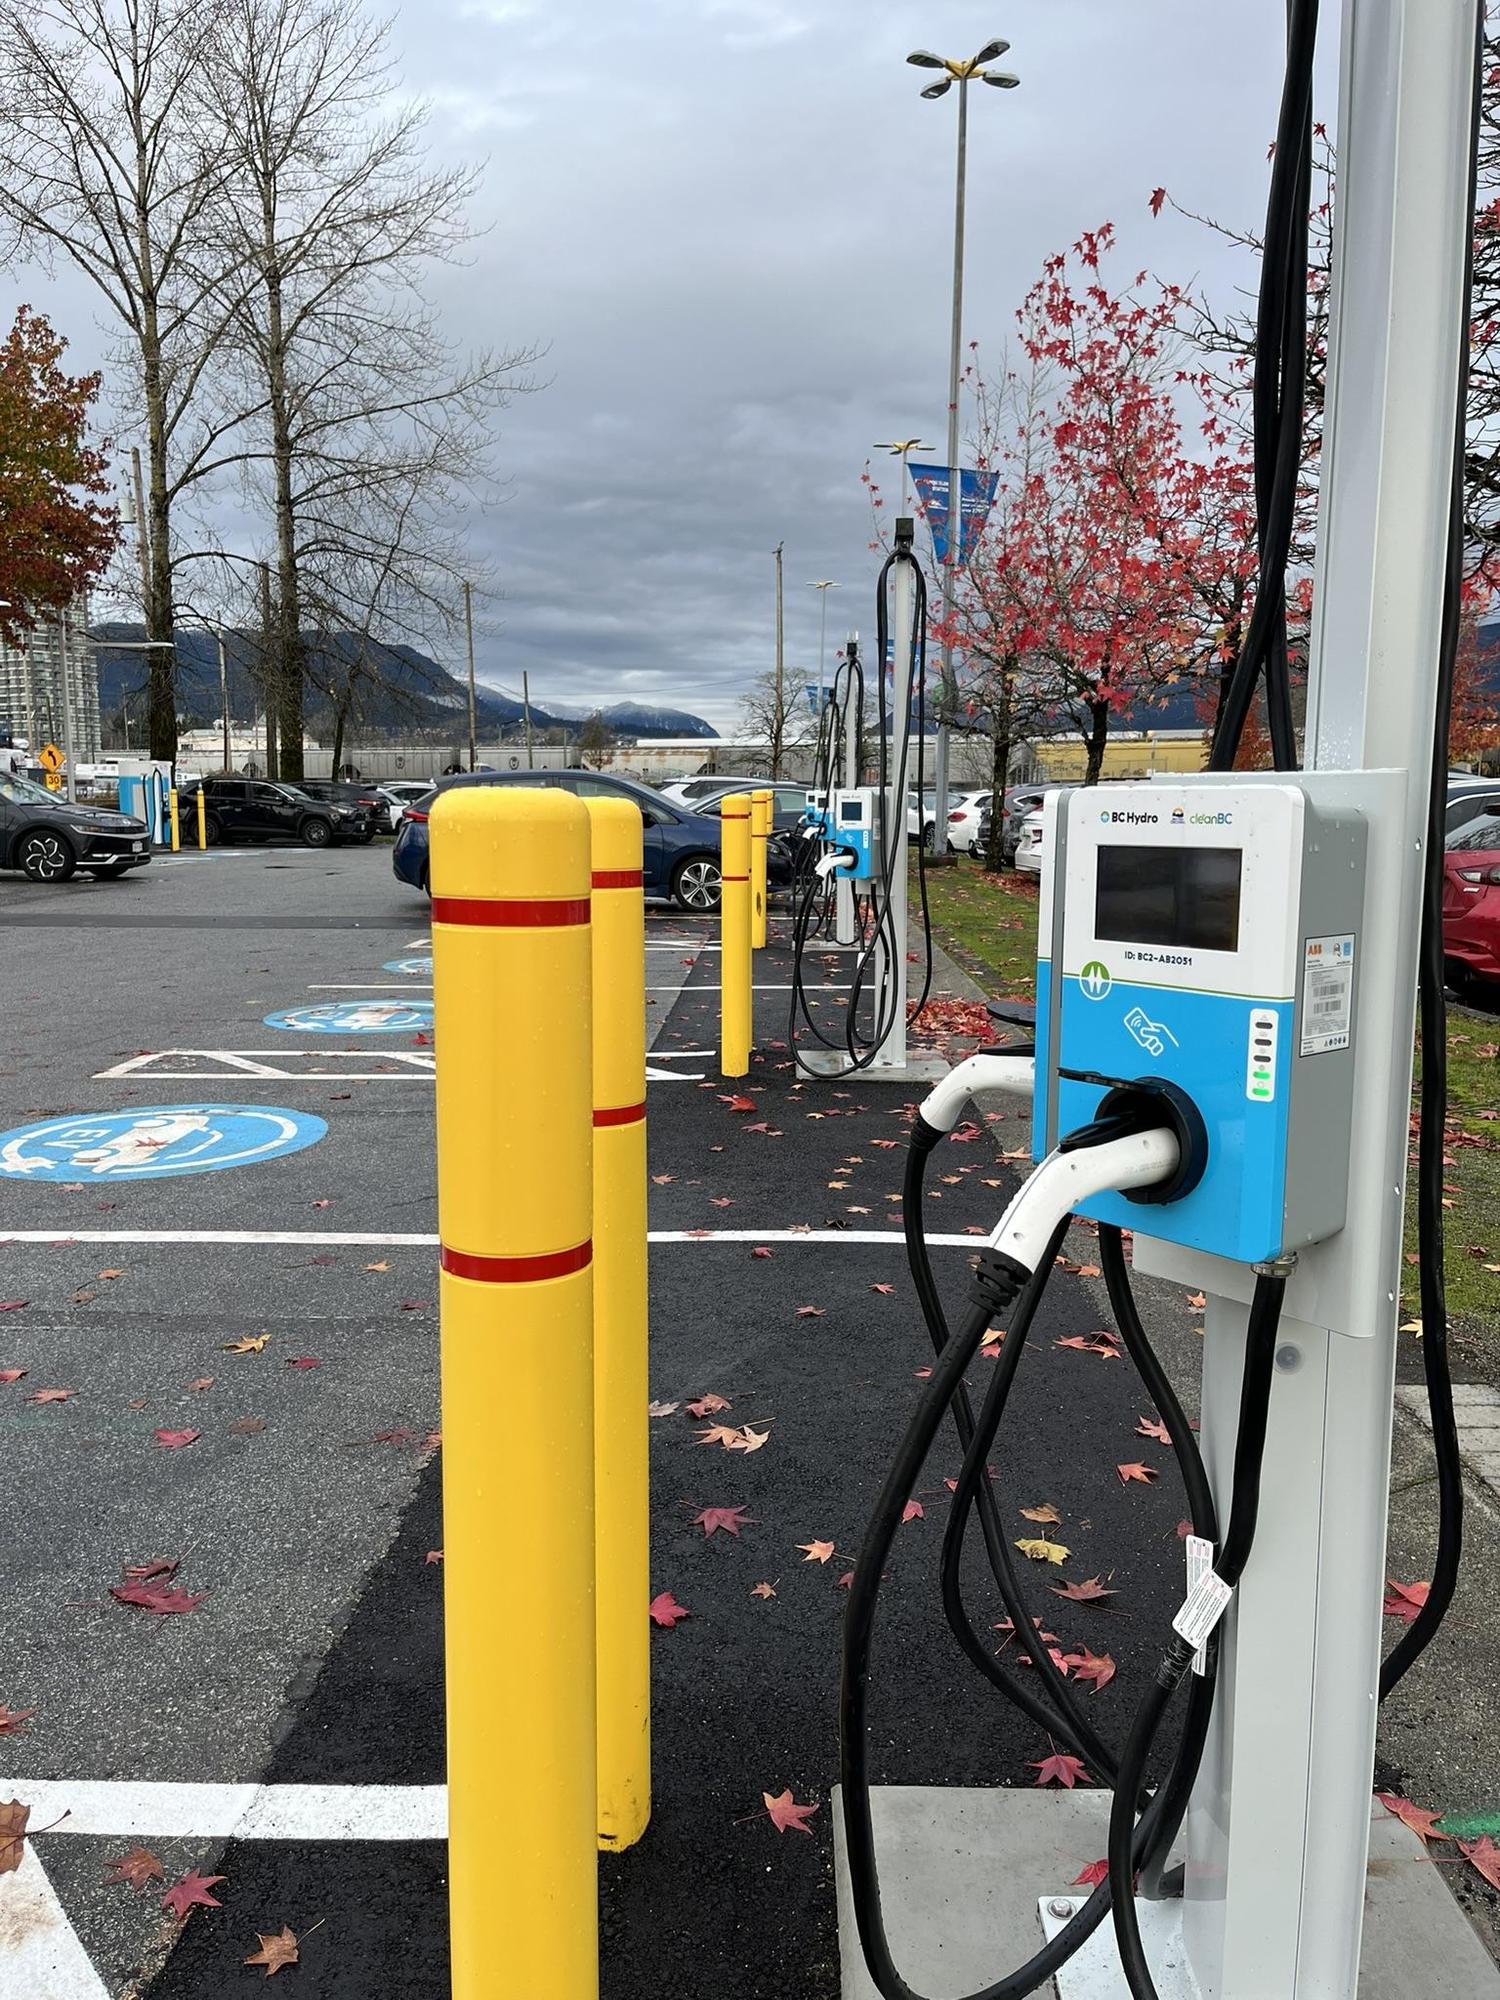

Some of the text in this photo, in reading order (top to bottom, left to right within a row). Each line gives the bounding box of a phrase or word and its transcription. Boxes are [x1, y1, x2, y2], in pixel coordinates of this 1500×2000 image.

[48, 776, 59, 784] 30
[1111, 812, 1126, 823] BC
[1126, 811, 1159, 826] Hydro
[1189, 812, 1233, 825] cleanBC
[1124, 950, 1136, 960] ID:
